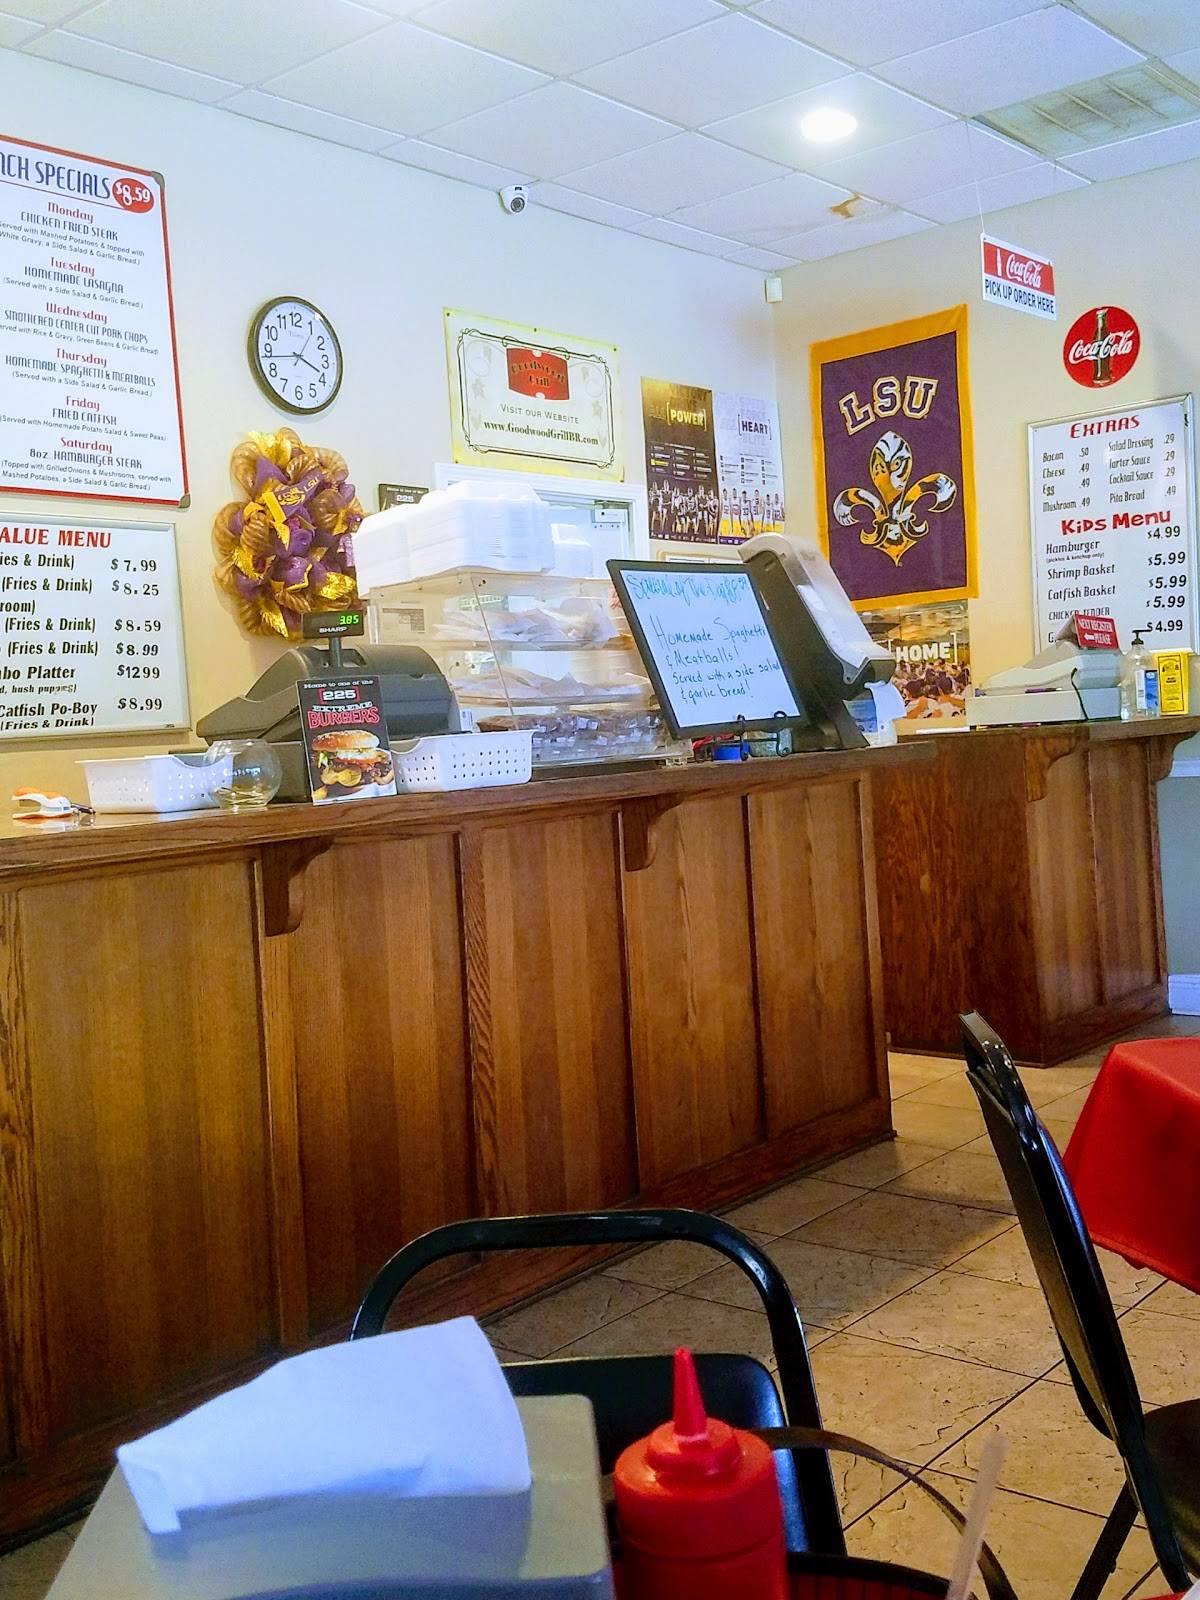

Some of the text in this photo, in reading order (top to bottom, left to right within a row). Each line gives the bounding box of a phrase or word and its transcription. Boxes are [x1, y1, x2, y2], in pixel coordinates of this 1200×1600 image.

[35, 161, 111, 199] SPECIALS
[115, 181, 151, 206] $8.59
[48, 202, 93, 224] Monday
[21, 211, 118, 241] CHICKEN FRIED STEAK
[51, 257, 95, 277] Tuesday
[1006, 253, 1042, 289] Coca-Cola
[24, 266, 123, 293] HOMEMADE LASAGNA
[985, 278, 1055, 314] PICK UP ORDER HERE
[46, 302, 107, 324] Wednesday
[289, 311, 303, 328] 12
[5, 310, 148, 344] SMOTHERED CENTER CUT PORK CHOPS
[277, 314, 287, 330] 11
[308, 320, 313, 335] 1
[265, 325, 278, 341] 10
[264, 343, 273, 358] 9
[316, 335, 325, 351] 2
[1069, 329, 1134, 364] Coca-Cola
[57, 348, 107, 368] Thursday
[321, 354, 330, 370] 3
[6, 355, 156, 387] HOMEMADE SPAGHETTI & MEATBALLS
[269, 362, 278, 378] 8
[280, 377, 288, 393] 7
[318, 372, 327, 387] 4
[294, 385, 303, 400] 6
[309, 383, 317, 398] 5
[66, 396, 100, 412] Friday
[838, 375, 938, 436] LSU
[52, 408, 117, 426] FRIED CATFISH
[484, 421, 599, 446] www.GoodwoodGrillBR.com
[741, 420, 769, 435] HEART
[60, 436, 112, 454] Saturday
[1108, 438, 1126, 451] Salad
[1127, 437, 1154, 450] Dressing
[54, 450, 113, 467] HAMBURGER
[116, 457, 142, 469] STEAK
[1042, 452, 1064, 463] Bacon
[1109, 458, 1129, 469] Tarter
[1131, 455, 1150, 466] Sauce
[68, 476, 81, 484] Side
[84, 478, 104, 486] Salad
[1042, 468, 1066, 479] Cheese
[1109, 471, 1135, 485] Cocktail
[1136, 470, 1154, 482] Sauce
[1042, 484, 1055, 496] Egg
[1109, 493, 1123, 504] Pita
[1125, 490, 1145, 501] Bread
[1042, 501, 1077, 513] Mushroom
[1112, 510, 1171, 530] Menu
[58, 530, 112, 548] MENU
[1147, 526, 1181, 539] $4.99
[1046, 540, 1101, 554] Hamburger
[24, 553, 31, 566] &
[38, 554, 74, 570] Drink)
[1047, 551, 1186, 580] Shrimp Basket $5.99
[2, 576, 37, 592] (Fries
[42, 578, 50, 591] &
[56, 578, 92, 594] Drink)
[1048, 574, 1187, 601] Catfish Basket $5.99
[1146, 595, 1185, 608] $5.99
[5, 617, 40, 633] (Fries
[45, 618, 53, 631] &
[60, 617, 95, 633] Drink)
[1147, 619, 1183, 632] $4.99
[8, 641, 43, 658] (Fries
[48, 641, 56, 654] &
[62, 640, 98, 656] Drink)
[895, 642, 951, 662] HOME
[0, 666, 21, 680] bo
[27, 666, 76, 679] Platter
[322, 689, 357, 700] 225
[0, 703, 45, 718] Catfish
[50, 702, 98, 716] Po-Boy
[308, 707, 380, 728] BURGERS
[0, 717, 94, 731] (Fries & Drink)
